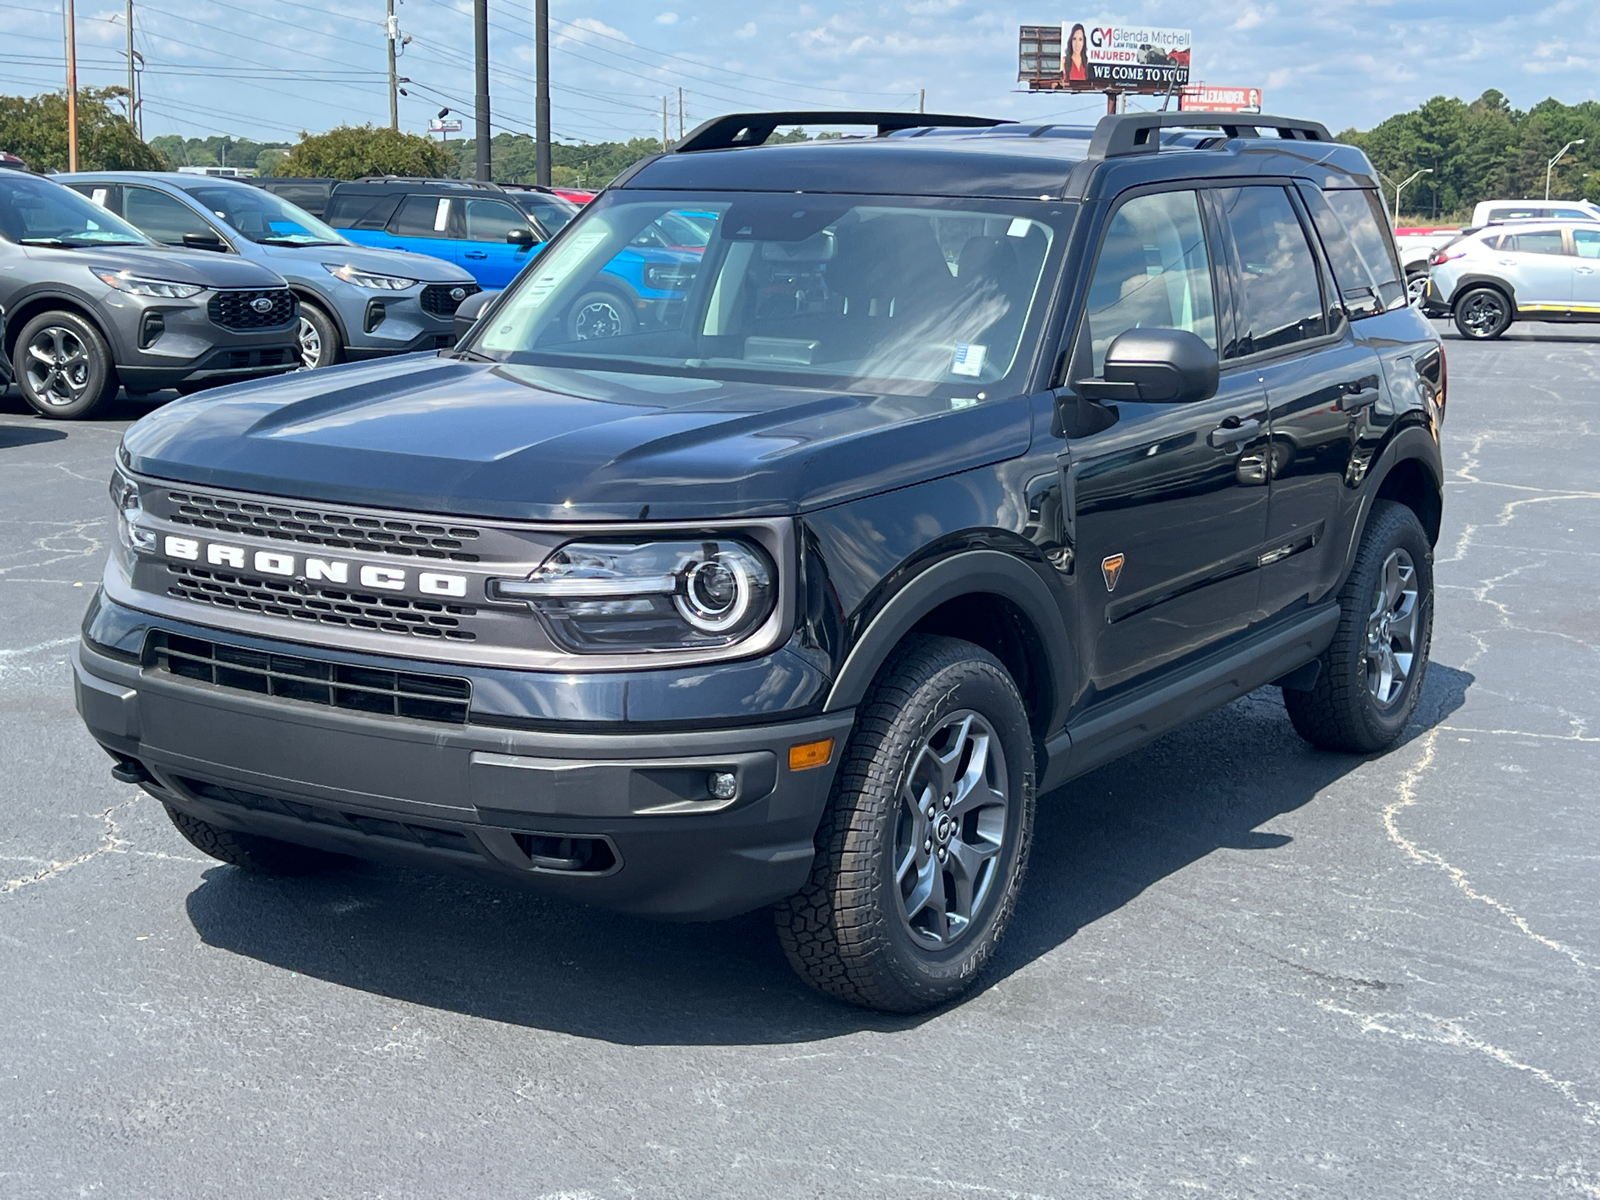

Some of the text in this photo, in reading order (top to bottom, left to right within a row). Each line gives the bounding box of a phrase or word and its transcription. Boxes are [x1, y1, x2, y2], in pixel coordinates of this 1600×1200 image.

[1091, 27, 1112, 47] GM
[1113, 28, 1190, 45] Glenda Mitchell
[1091, 50, 1136, 61] INJURED?
[1093, 65, 1188, 82] WE COME TO YOU!
[164, 535, 467, 598] BRONCO
